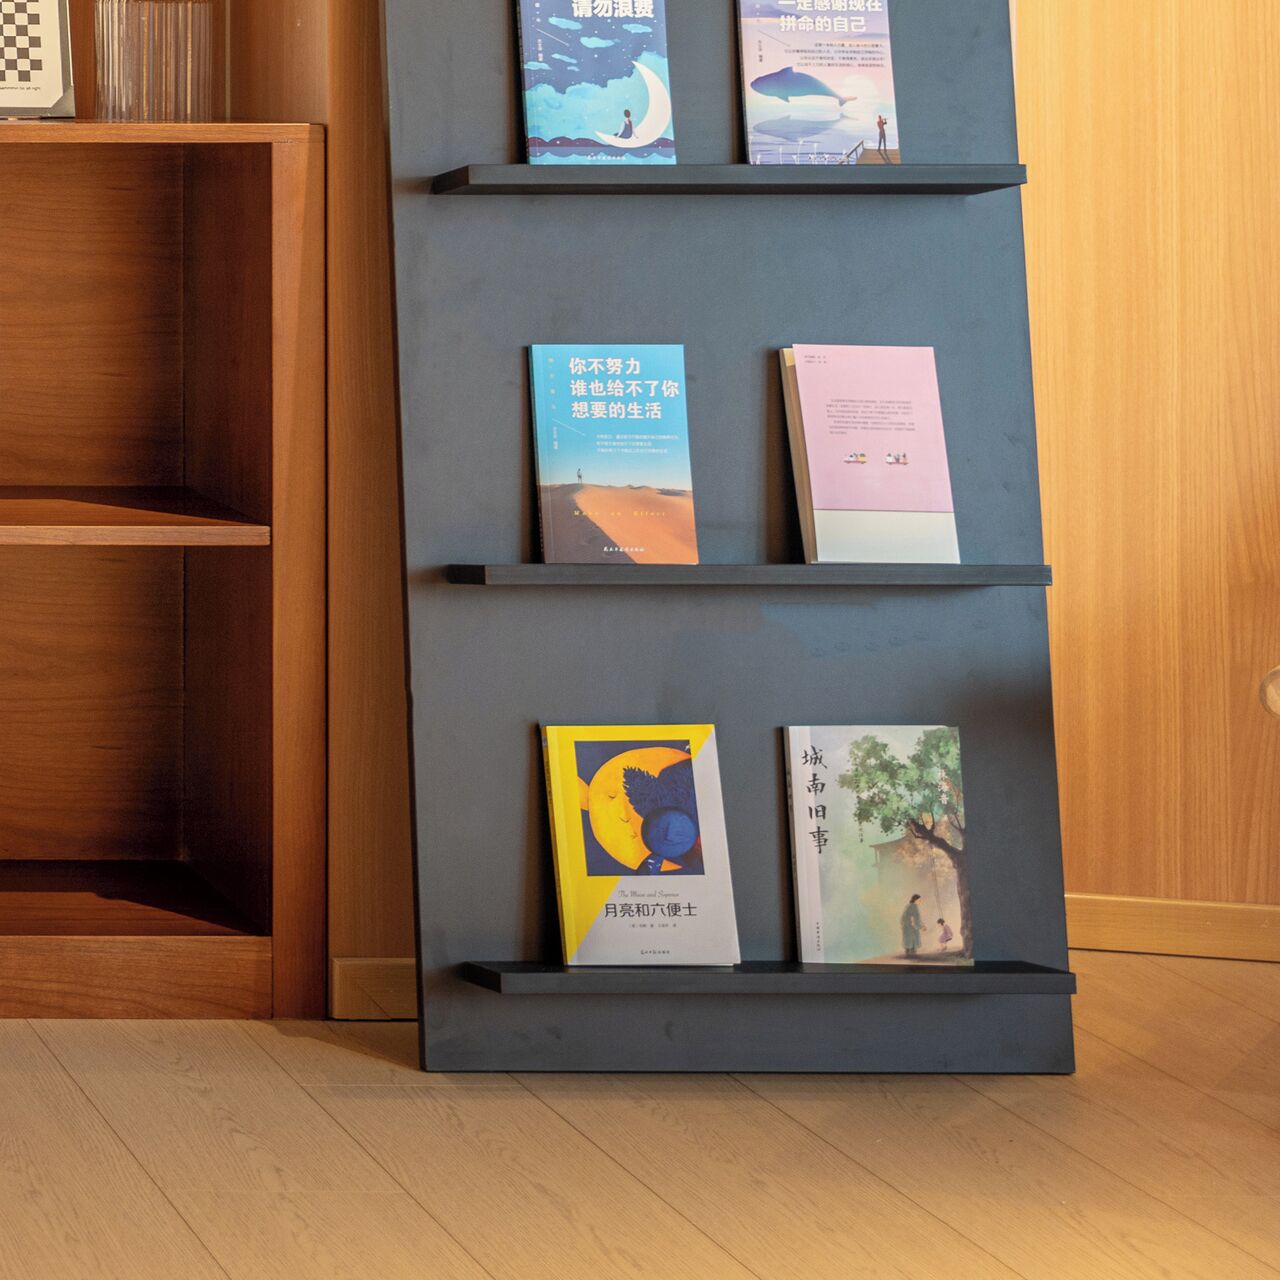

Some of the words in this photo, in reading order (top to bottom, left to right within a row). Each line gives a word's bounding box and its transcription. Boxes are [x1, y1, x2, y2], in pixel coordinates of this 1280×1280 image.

[780, 15, 867, 33] 拼命的自己
[569, 357, 640, 375] 你不努力
[570, 379, 680, 398] 谁也给不了你
[571, 401, 662, 419] 想要的生活
[801, 745, 829, 854] 城南旧事
[604, 902, 697, 918] 月亮和六便士
